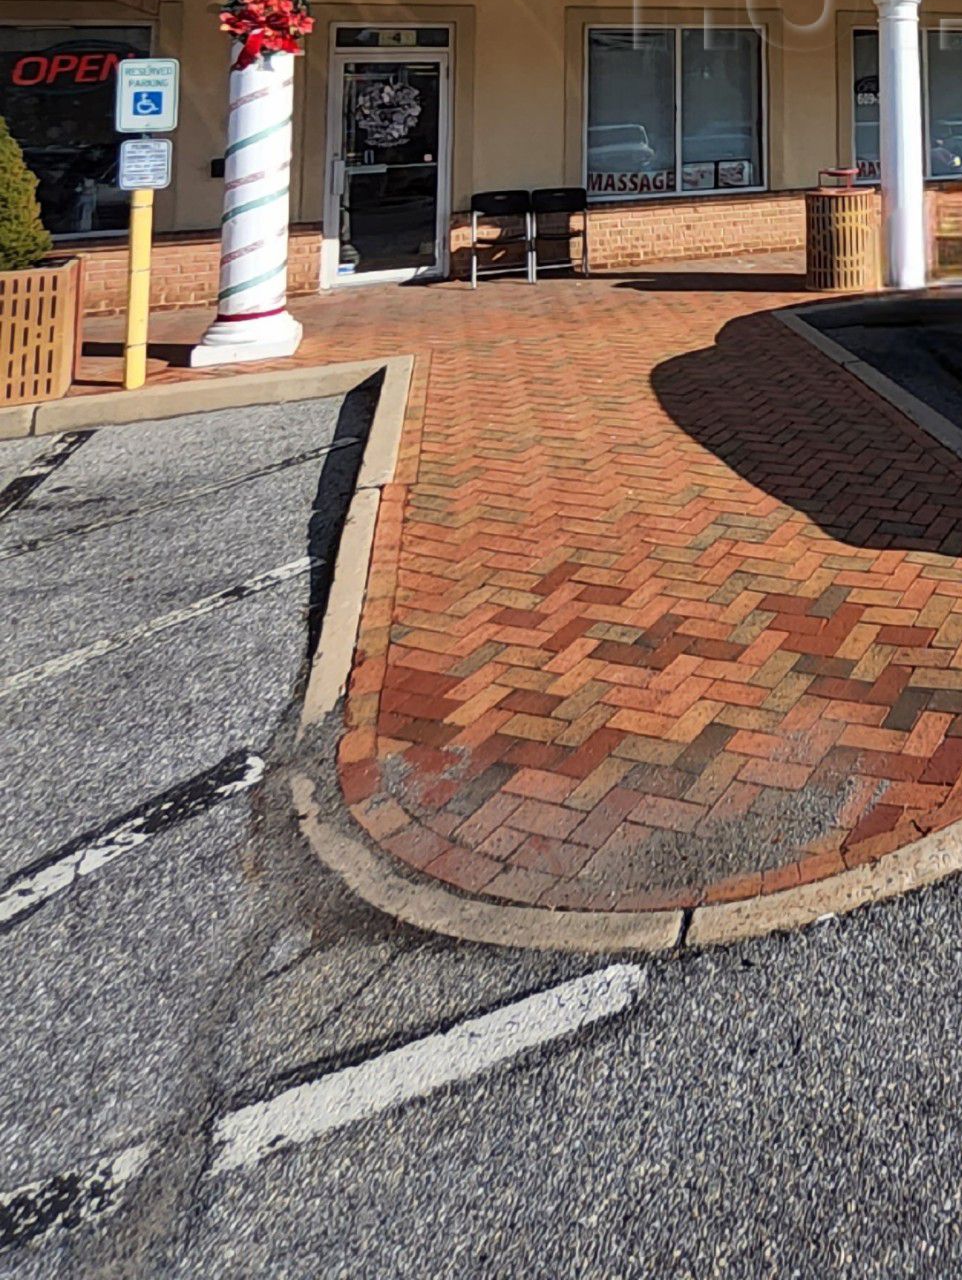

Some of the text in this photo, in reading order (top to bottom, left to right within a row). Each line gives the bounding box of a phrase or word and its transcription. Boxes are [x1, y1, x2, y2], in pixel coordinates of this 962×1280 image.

[125, 67, 173, 76] RESERVED
[128, 79, 169, 87] PARKING
[587, 171, 676, 192] MASSAGE
